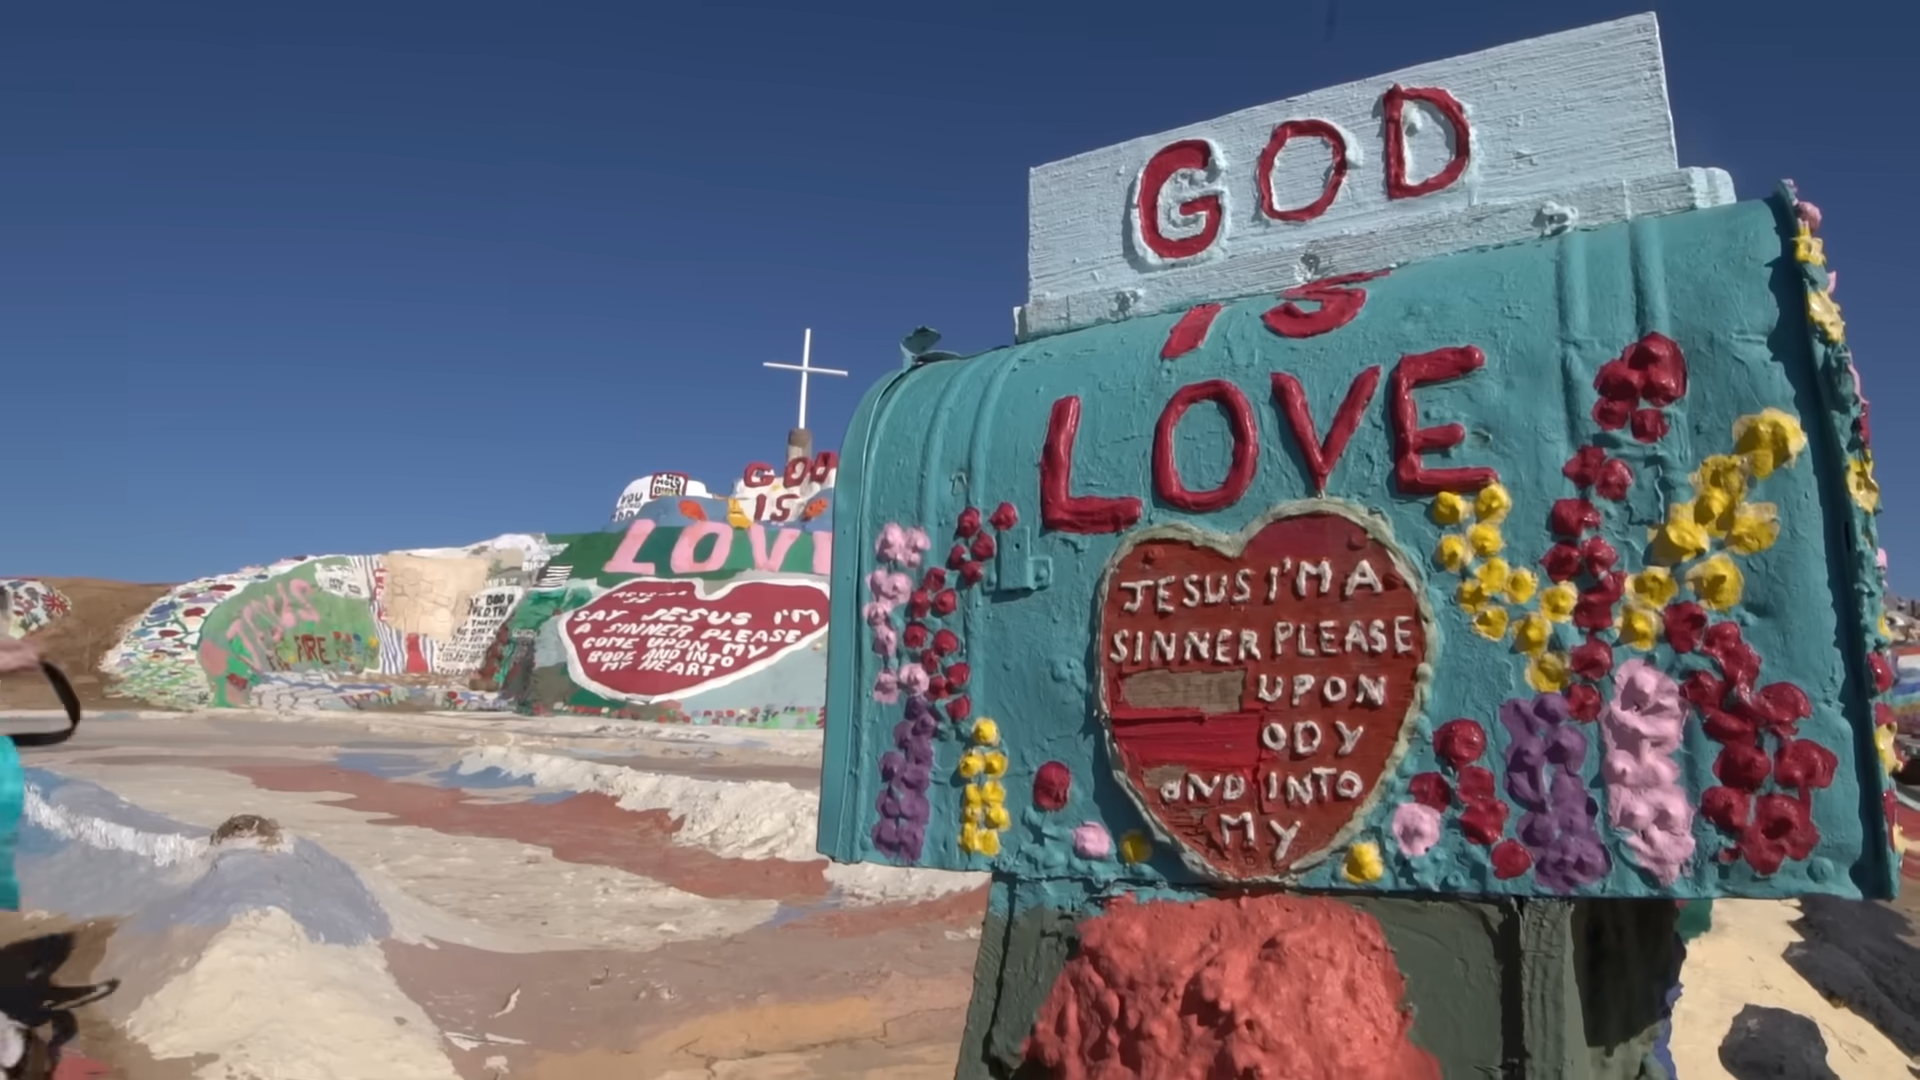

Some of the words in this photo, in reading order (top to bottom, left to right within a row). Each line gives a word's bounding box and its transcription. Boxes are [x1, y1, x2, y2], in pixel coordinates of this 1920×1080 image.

[1136, 84, 1471, 259] GOD
[1039, 345, 1498, 533] LOVE
[753, 493, 800, 523] IS
[1121, 568, 1252, 613] JESUS
[1268, 556, 1332, 601] I'M
[1344, 559, 1383, 596] A
[573, 622, 592, 635] A
[603, 622, 694, 638] SINNER
[700, 628, 802, 643] PLEASE
[574, 609, 629, 622] SAY
[641, 607, 753, 626] JESUS
[773, 608, 820, 626] I'M
[582, 636, 640, 650] COME
[646, 637, 711, 653] UPON
[722, 642, 769, 660] MY
[1110, 629, 1261, 663] SINNER
[1274, 615, 1413, 656] PLEASE
[600, 661, 633, 673] MY
[637, 659, 716, 677] HEART
[641, 648, 681, 662] AND
[685, 649, 735, 668] INTO
[1258, 673, 1386, 706] UPON
[1269, 767, 1364, 805] INTO
[1220, 812, 1301, 861] MY
